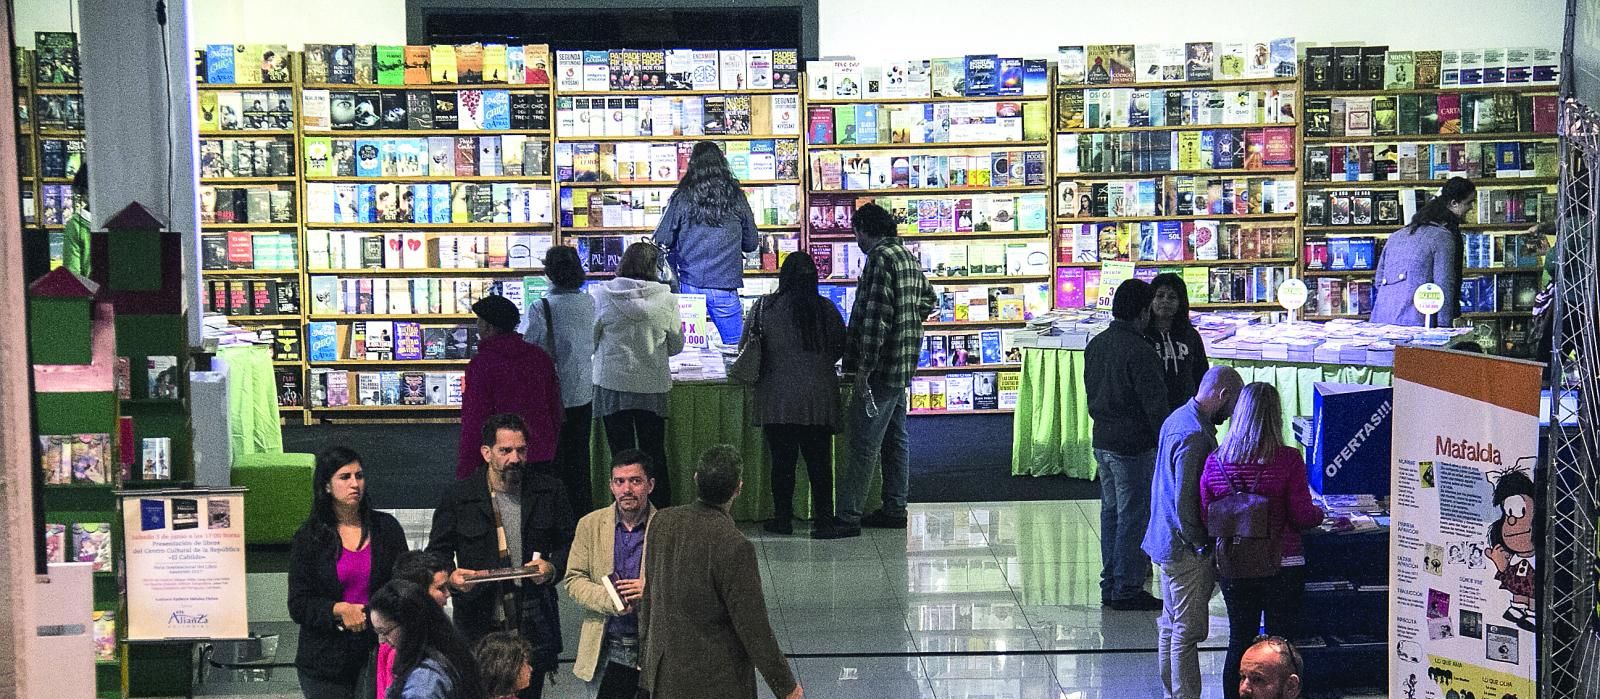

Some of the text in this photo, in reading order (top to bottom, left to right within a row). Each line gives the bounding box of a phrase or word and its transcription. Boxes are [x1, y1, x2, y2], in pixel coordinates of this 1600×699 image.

[1109, 287, 1115, 297] 3
[1325, 400, 1392, 478] OFERTAS!!!
[1435, 434, 1503, 467] Mafalda
